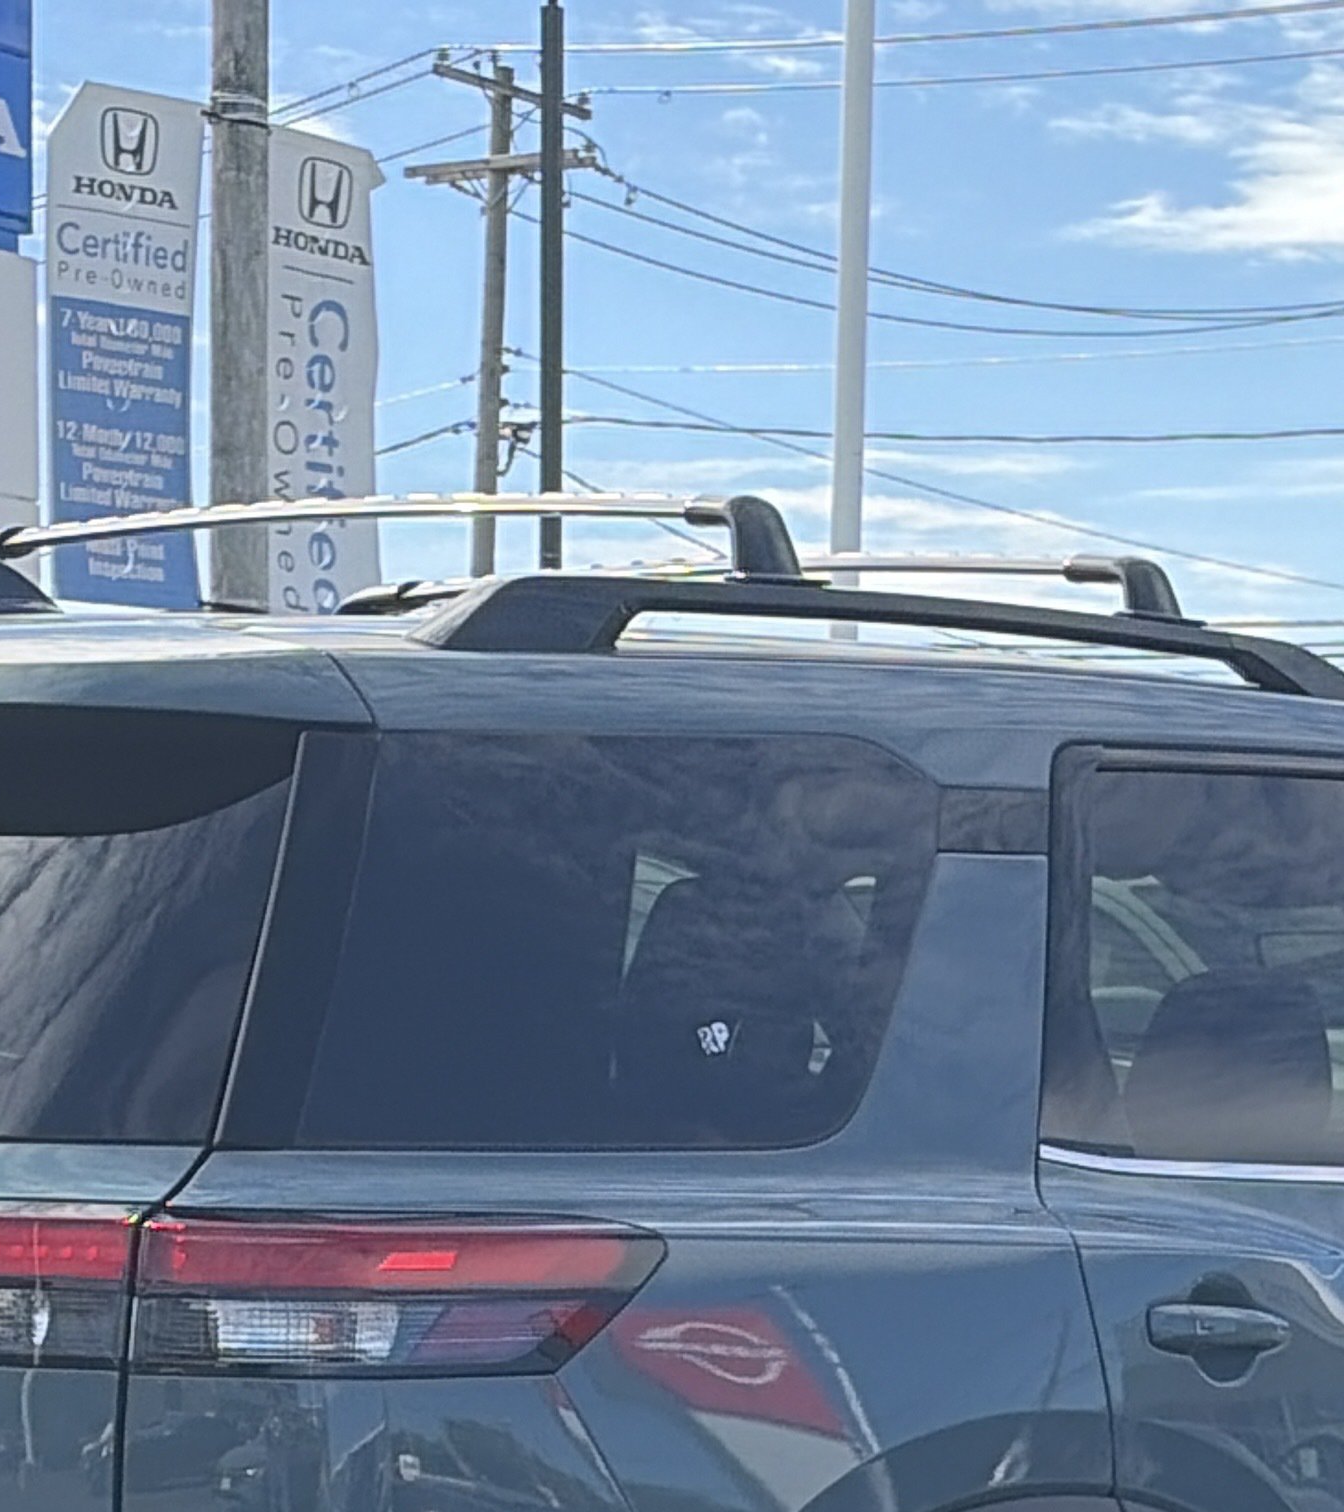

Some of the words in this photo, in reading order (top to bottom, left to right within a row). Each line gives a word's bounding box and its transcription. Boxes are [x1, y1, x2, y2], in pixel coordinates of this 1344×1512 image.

[72, 175, 179, 210] HONDA
[57, 221, 189, 273] Certified
[272, 225, 370, 266] HONDA
[58, 260, 186, 300] Pre-Owned
